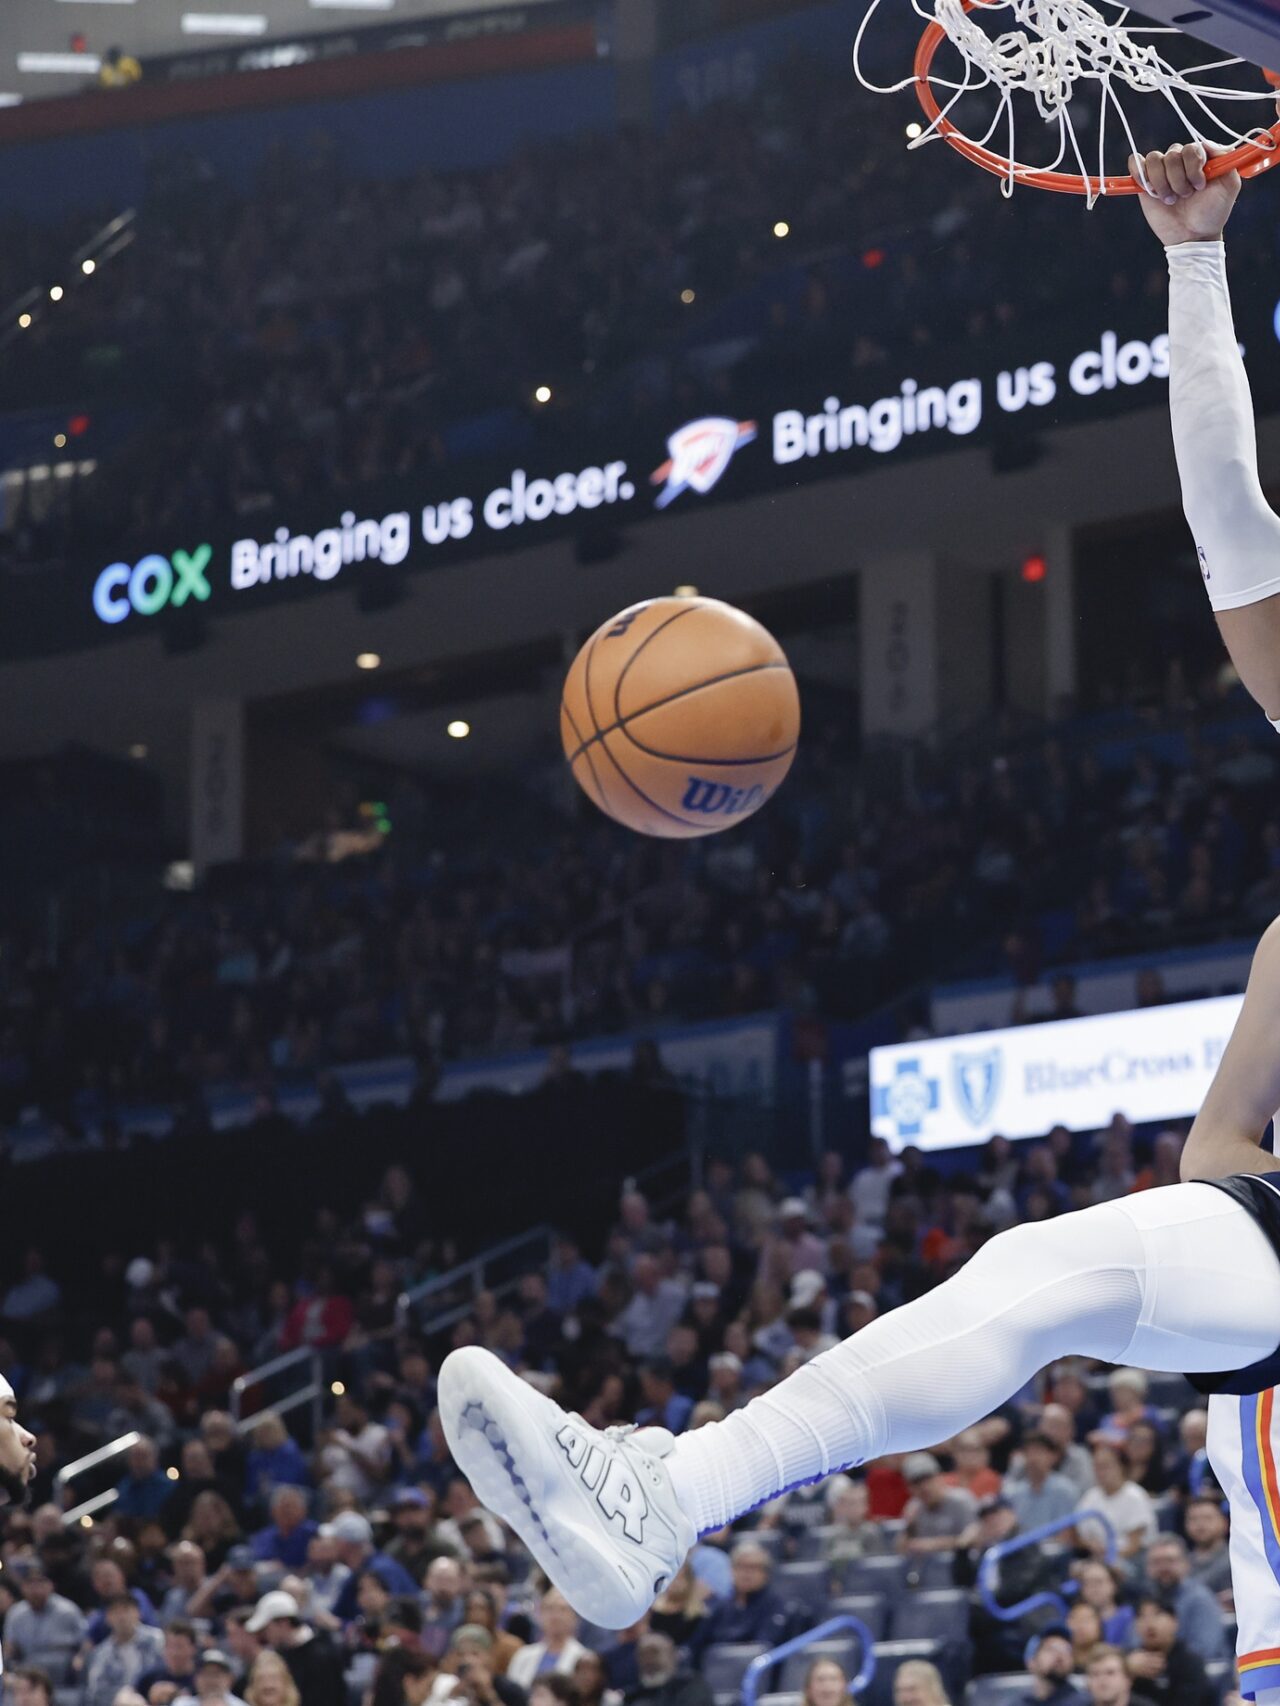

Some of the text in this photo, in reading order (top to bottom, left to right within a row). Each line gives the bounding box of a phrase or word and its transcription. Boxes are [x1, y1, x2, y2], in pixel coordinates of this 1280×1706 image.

[773, 378, 983, 465] Bringing
[996, 361, 1056, 412] us
[93, 461, 635, 624] COX Bringing us closer.
[682, 775, 770, 815] Wil
[555, 1425, 649, 1545] AIR
